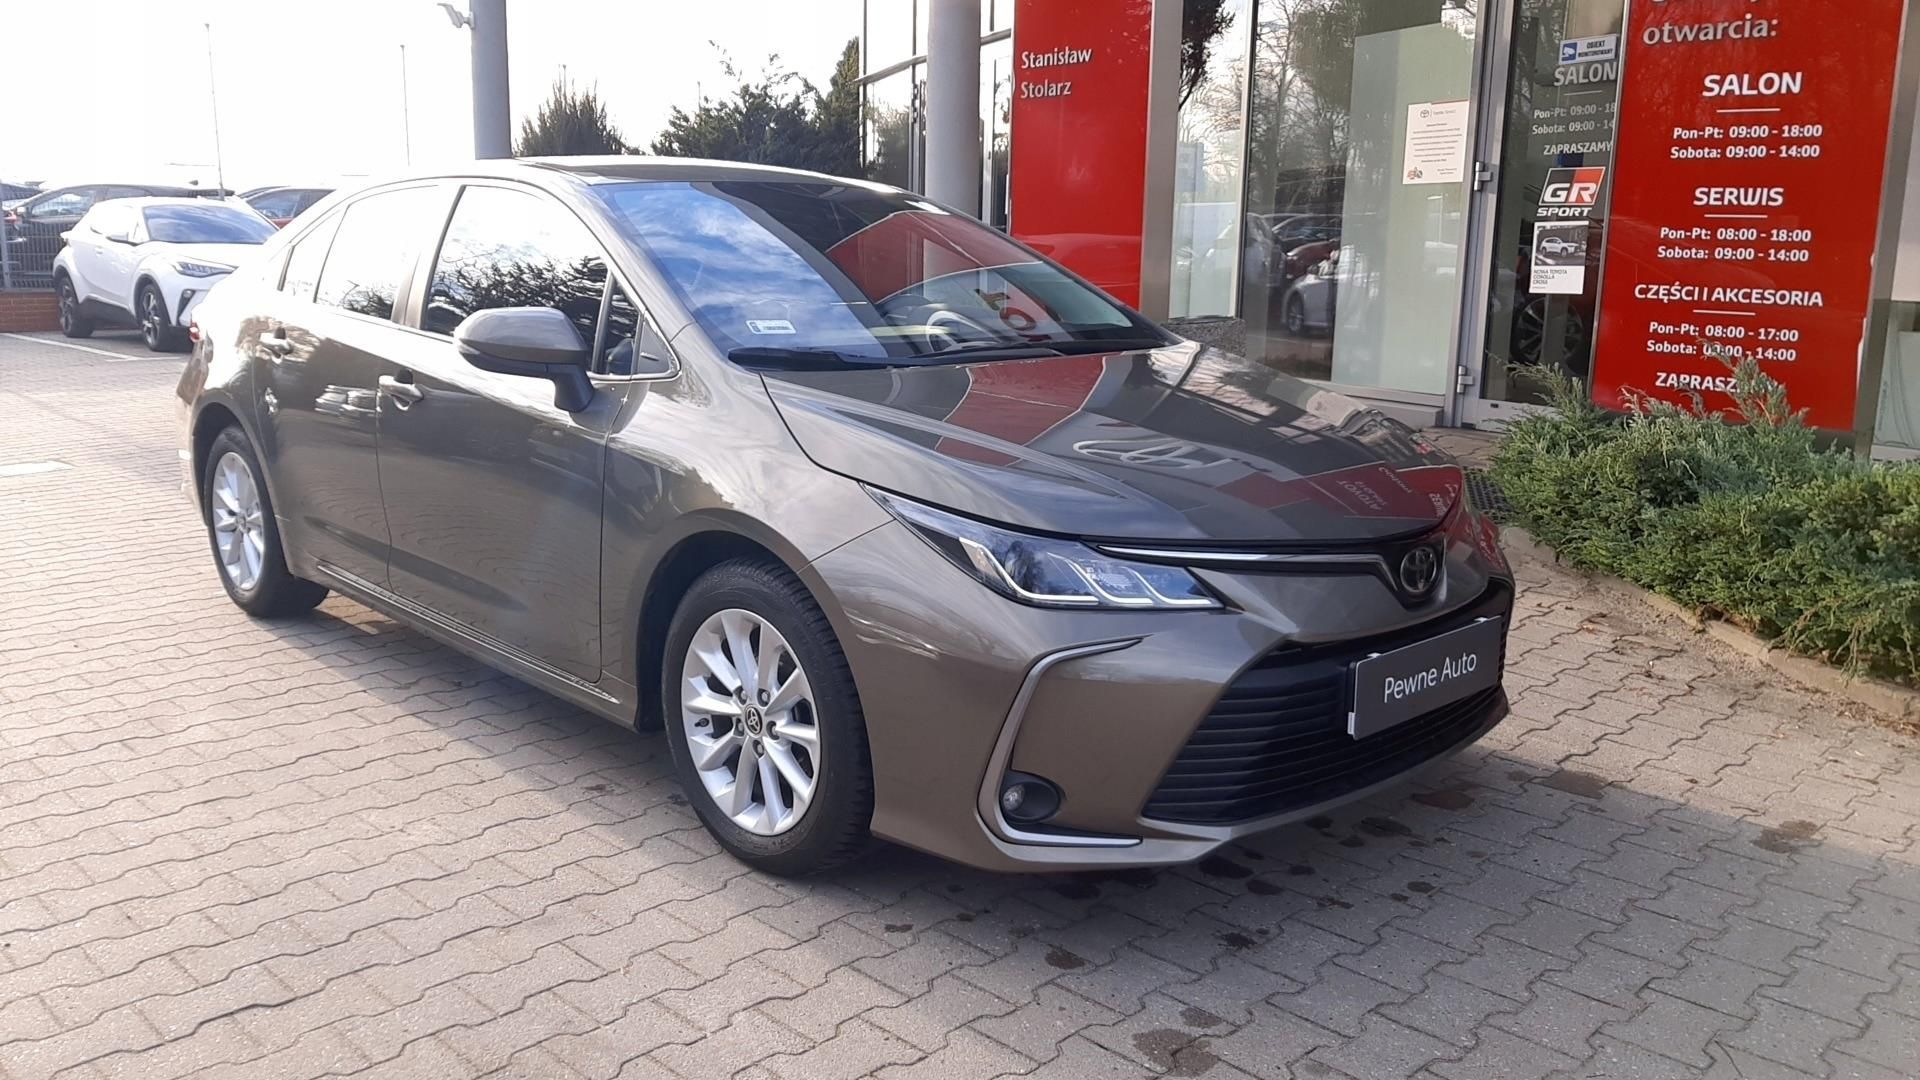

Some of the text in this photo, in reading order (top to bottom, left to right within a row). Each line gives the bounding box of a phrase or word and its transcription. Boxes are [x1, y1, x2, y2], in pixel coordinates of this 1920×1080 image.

[1642, 13, 1778, 45] otwarcia:
[1021, 46, 1092, 69] Stanisław
[1553, 62, 1617, 87] SALON
[1702, 71, 1802, 97] SALON
[1020, 79, 1072, 99] Stolarz
[1534, 107, 1567, 119] Pon-Pt:
[1570, 104, 1597, 116] 09:00
[1532, 124, 1566, 135] Sobota:
[1568, 121, 1595, 132] 09:00
[1673, 127, 1724, 140] Pon-Pt:
[1729, 125, 1769, 138] 09:00
[1781, 124, 1823, 138] 18:00
[1543, 141, 1613, 156] ZAPRASZAMY
[1670, 146, 1721, 159] Sobota:
[1726, 145, 1766, 158] 09:00
[1779, 144, 1820, 158] 14:00
[1543, 182, 1597, 203] GR
[1693, 187, 1784, 206] SERWIS
[1537, 207, 1592, 217] SPORT
[1660, 227, 1711, 240] Pon-Pt:
[1716, 228, 1757, 241] 08:00
[1770, 229, 1812, 242] 18:00
[1657, 246, 1709, 259] Sobota:
[1714, 248, 1755, 260] 09:00
[1767, 249, 1809, 262] 14:00
[1634, 281, 1823, 307] CZĘŚCI I AKCESORIA
[1649, 321, 1699, 336] Pon-Pt:
[1705, 325, 1744, 339] 08:00
[1757, 328, 1799, 342] 17:00
[1646, 340, 1697, 354] Sobota:
[1755, 347, 1796, 362] 14:00
[1655, 372, 1770, 394] ZAPRASZ
[1384, 652, 1477, 703] Pewne Auto
